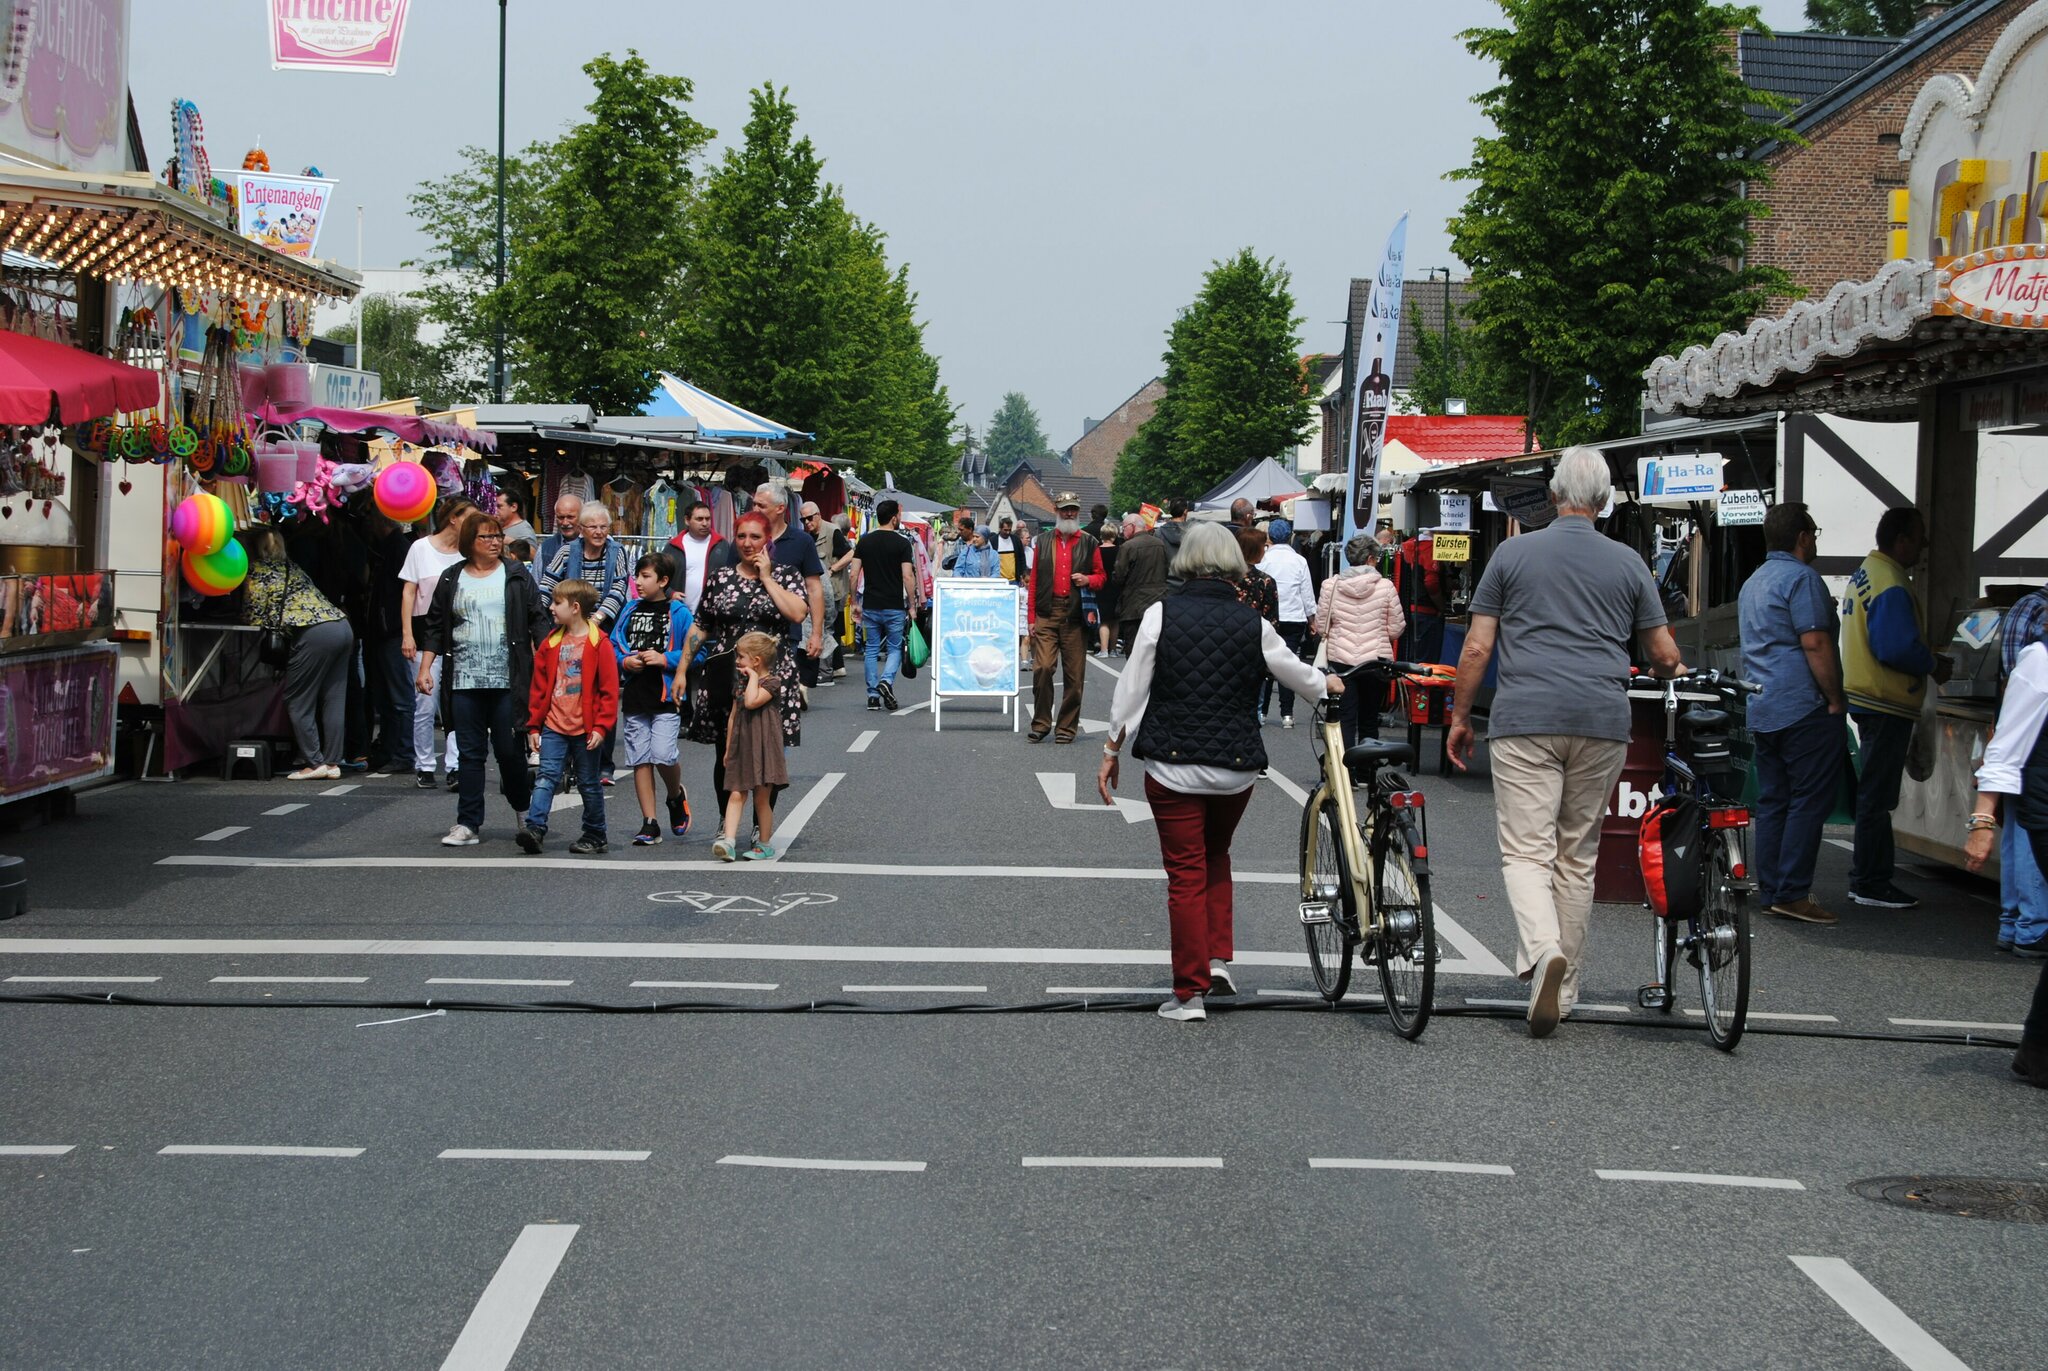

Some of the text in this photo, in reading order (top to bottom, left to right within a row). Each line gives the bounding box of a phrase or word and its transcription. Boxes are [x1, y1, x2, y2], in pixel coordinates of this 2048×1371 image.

[245, 181, 322, 212] Entenangeln
[1668, 464, 1714, 478] Ha-Ra
[1721, 510, 1763, 518] Vorwerk
[1722, 516, 1764, 526] Thermomix
[1436, 536, 1468, 549] Bürsten
[1437, 552, 1465, 560] aller Art
[955, 610, 1001, 633] Slush
